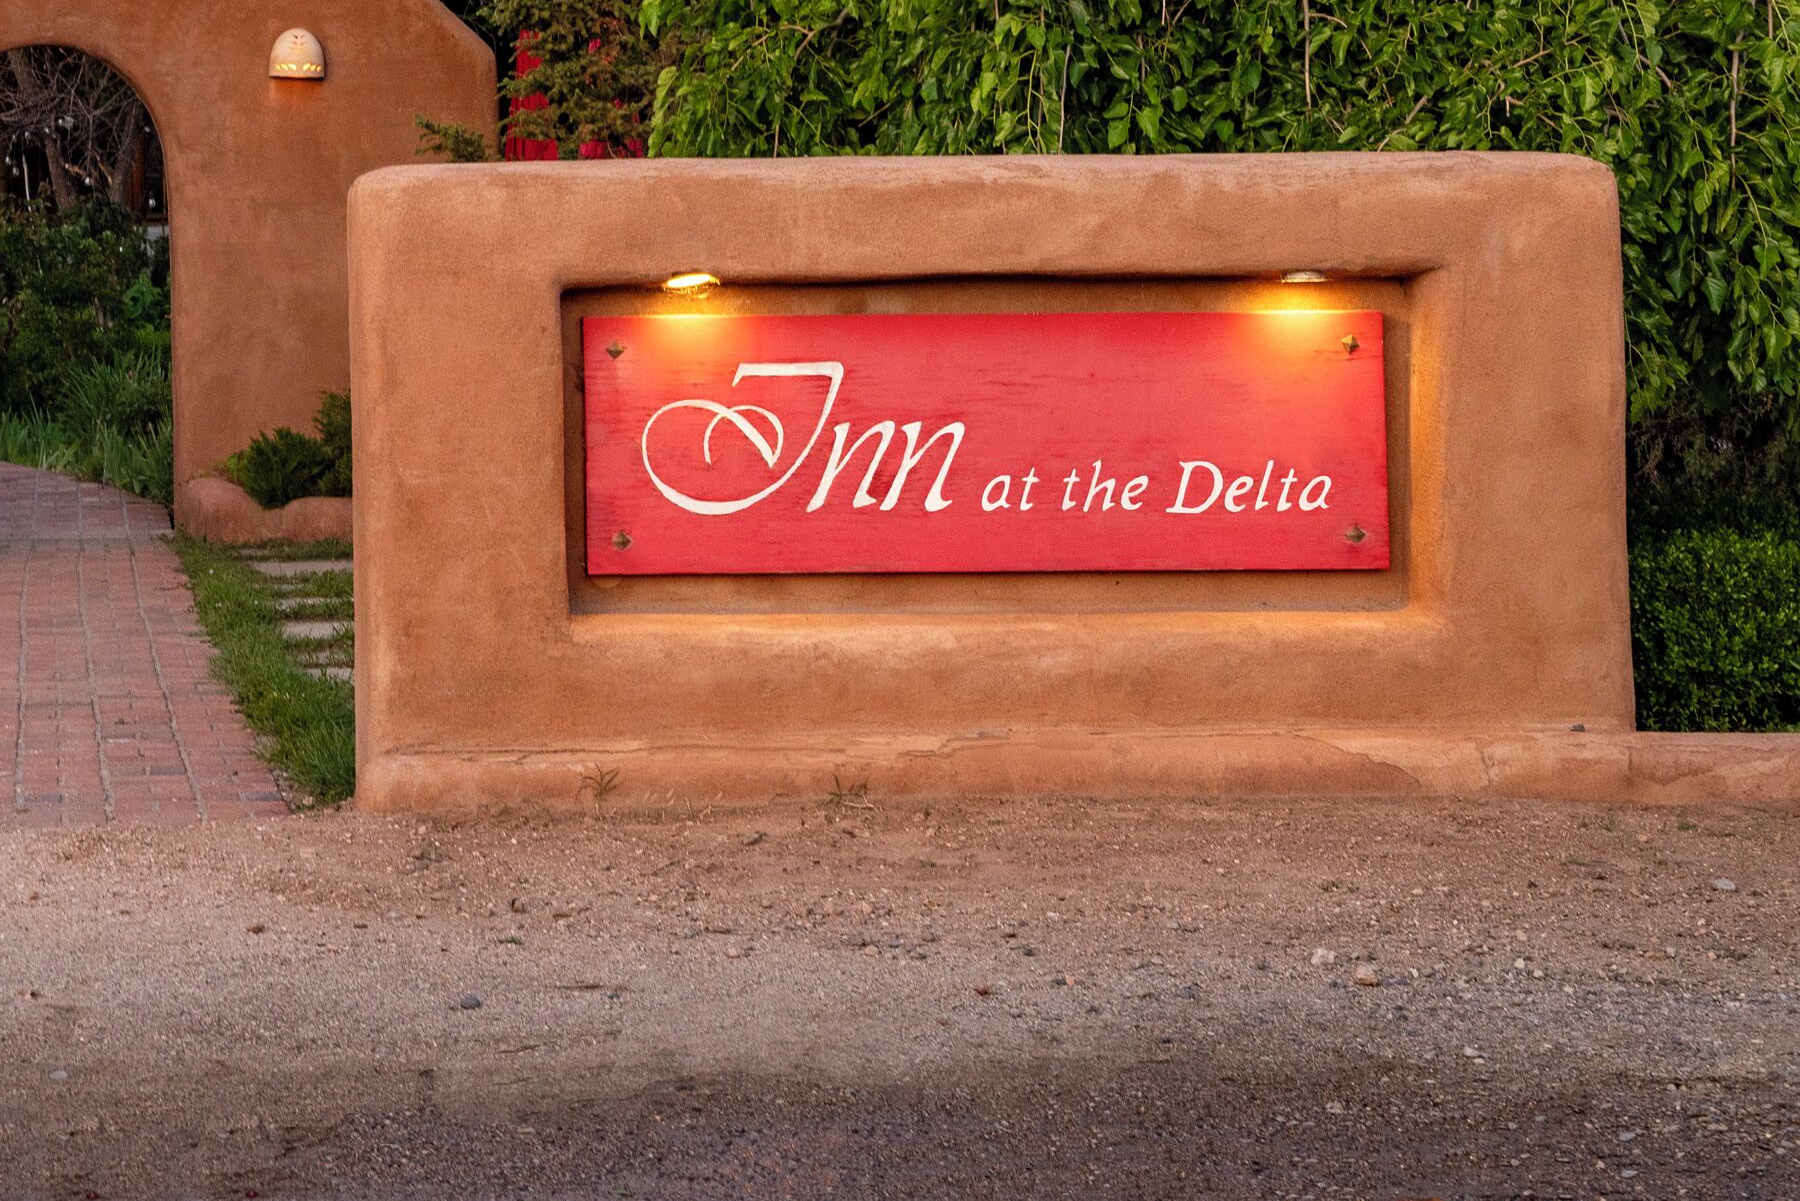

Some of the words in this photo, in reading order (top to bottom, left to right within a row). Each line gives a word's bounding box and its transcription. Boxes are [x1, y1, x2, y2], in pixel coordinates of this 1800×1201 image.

[641, 361, 966, 515] Inn
[981, 467, 1041, 513] at
[1061, 459, 1149, 513] the
[1165, 459, 1332, 515] Delta
